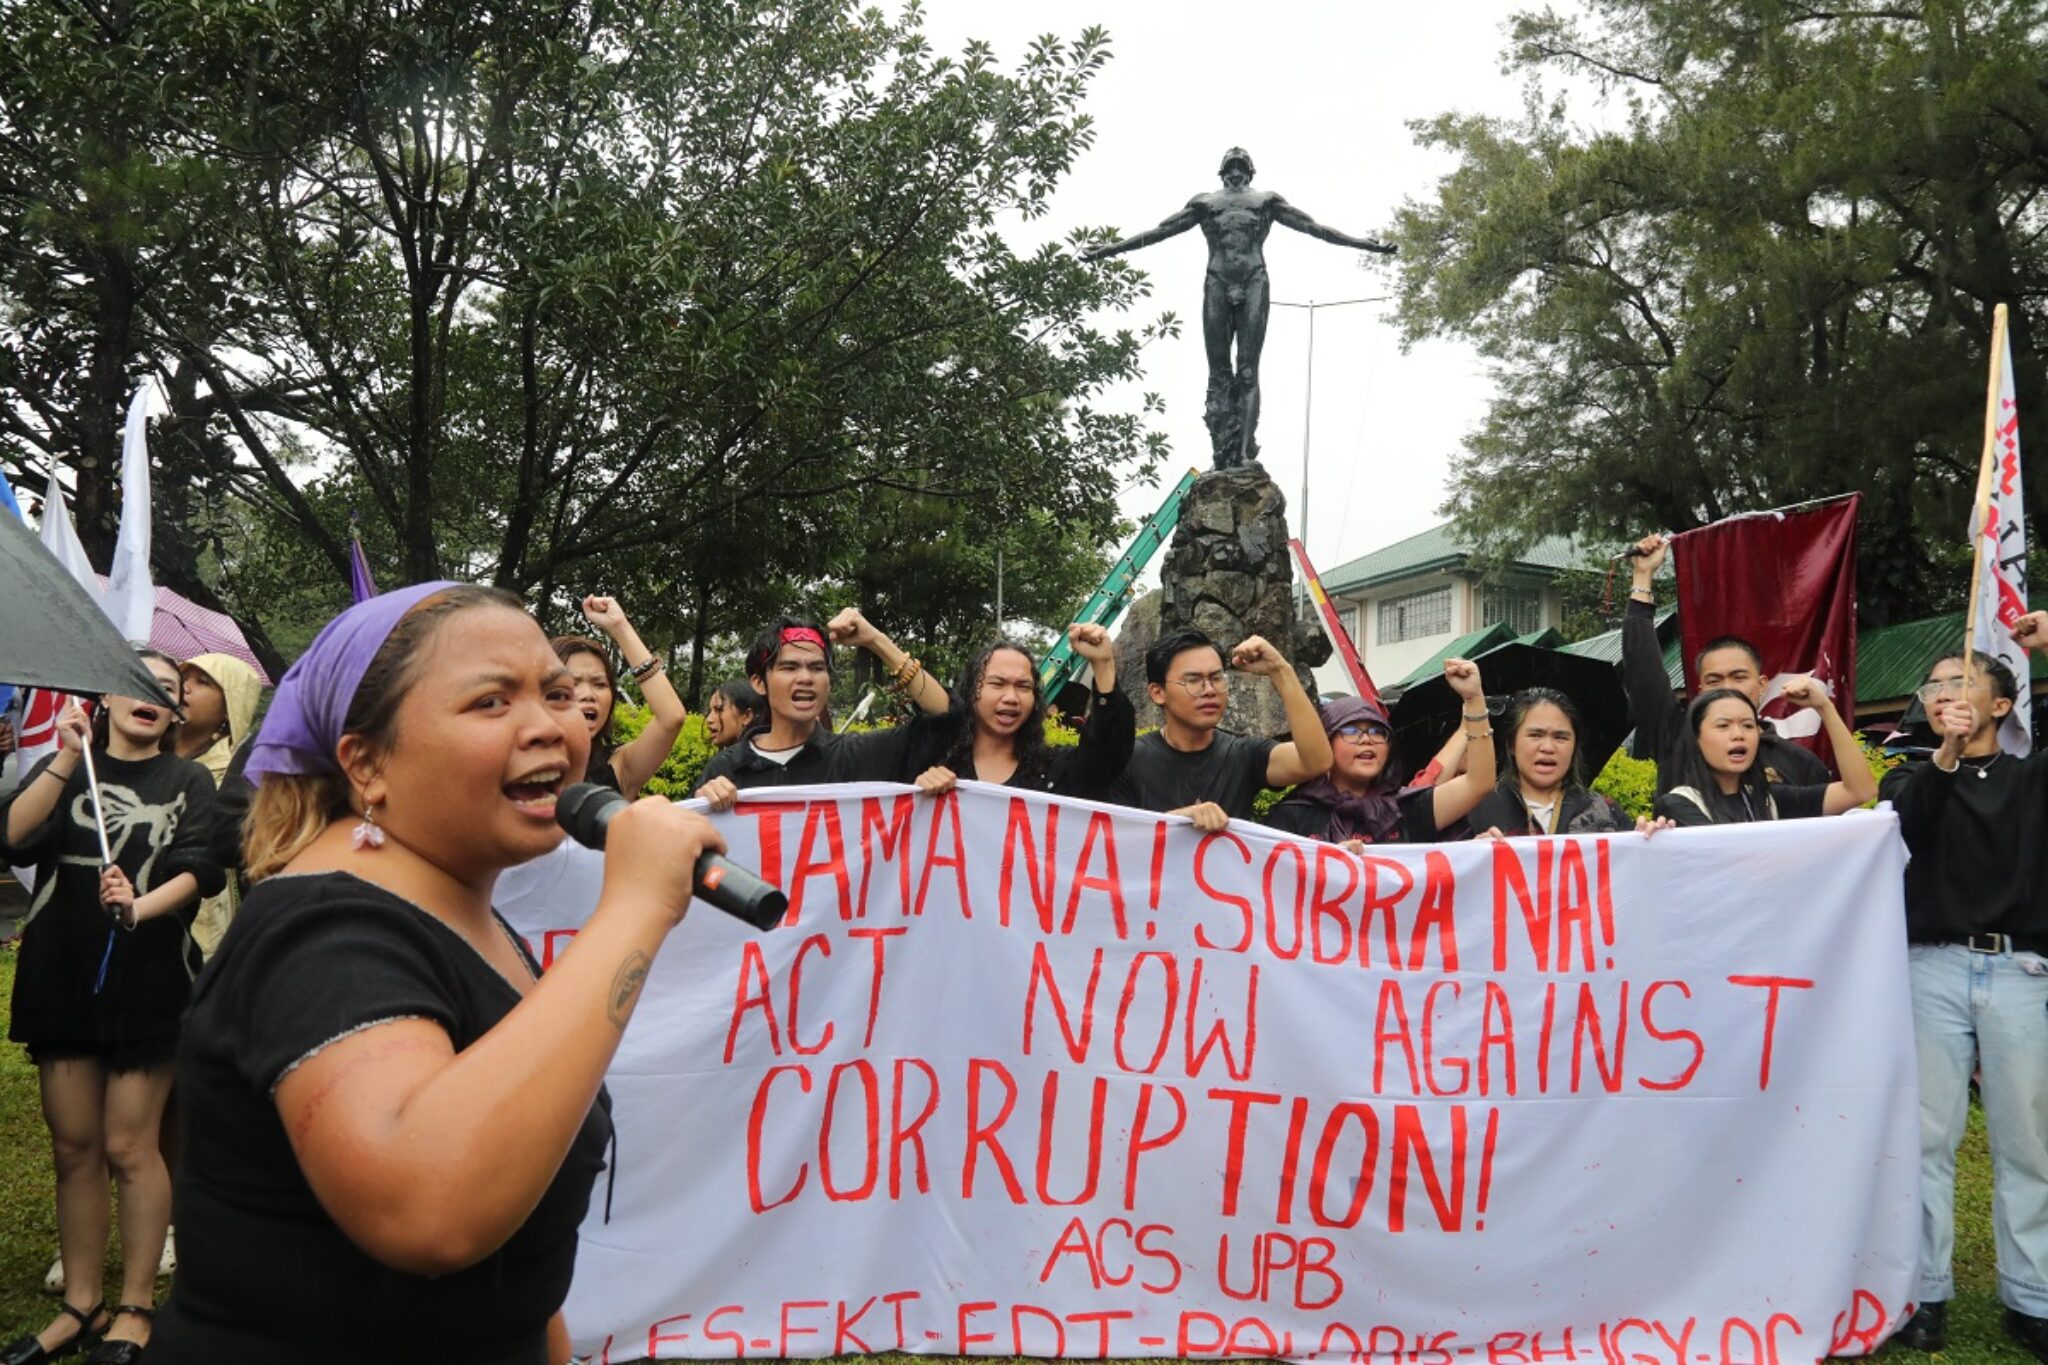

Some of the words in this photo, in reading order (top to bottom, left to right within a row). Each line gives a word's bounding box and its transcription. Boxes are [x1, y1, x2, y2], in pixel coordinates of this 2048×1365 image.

[733, 790, 973, 929] TAMA
[998, 795, 1168, 941] NA!
[1193, 830, 1460, 974] SOBRA
[1491, 838, 1616, 974] NA!
[723, 926, 908, 1065] ACT
[1023, 941, 1260, 1083] NOW
[1372, 974, 1815, 1098] AGAINST
[746, 1057, 1500, 1234] CORRUPTION!
[1039, 1216, 1183, 1296] ACS
[1217, 1231, 1345, 1312] UPB
